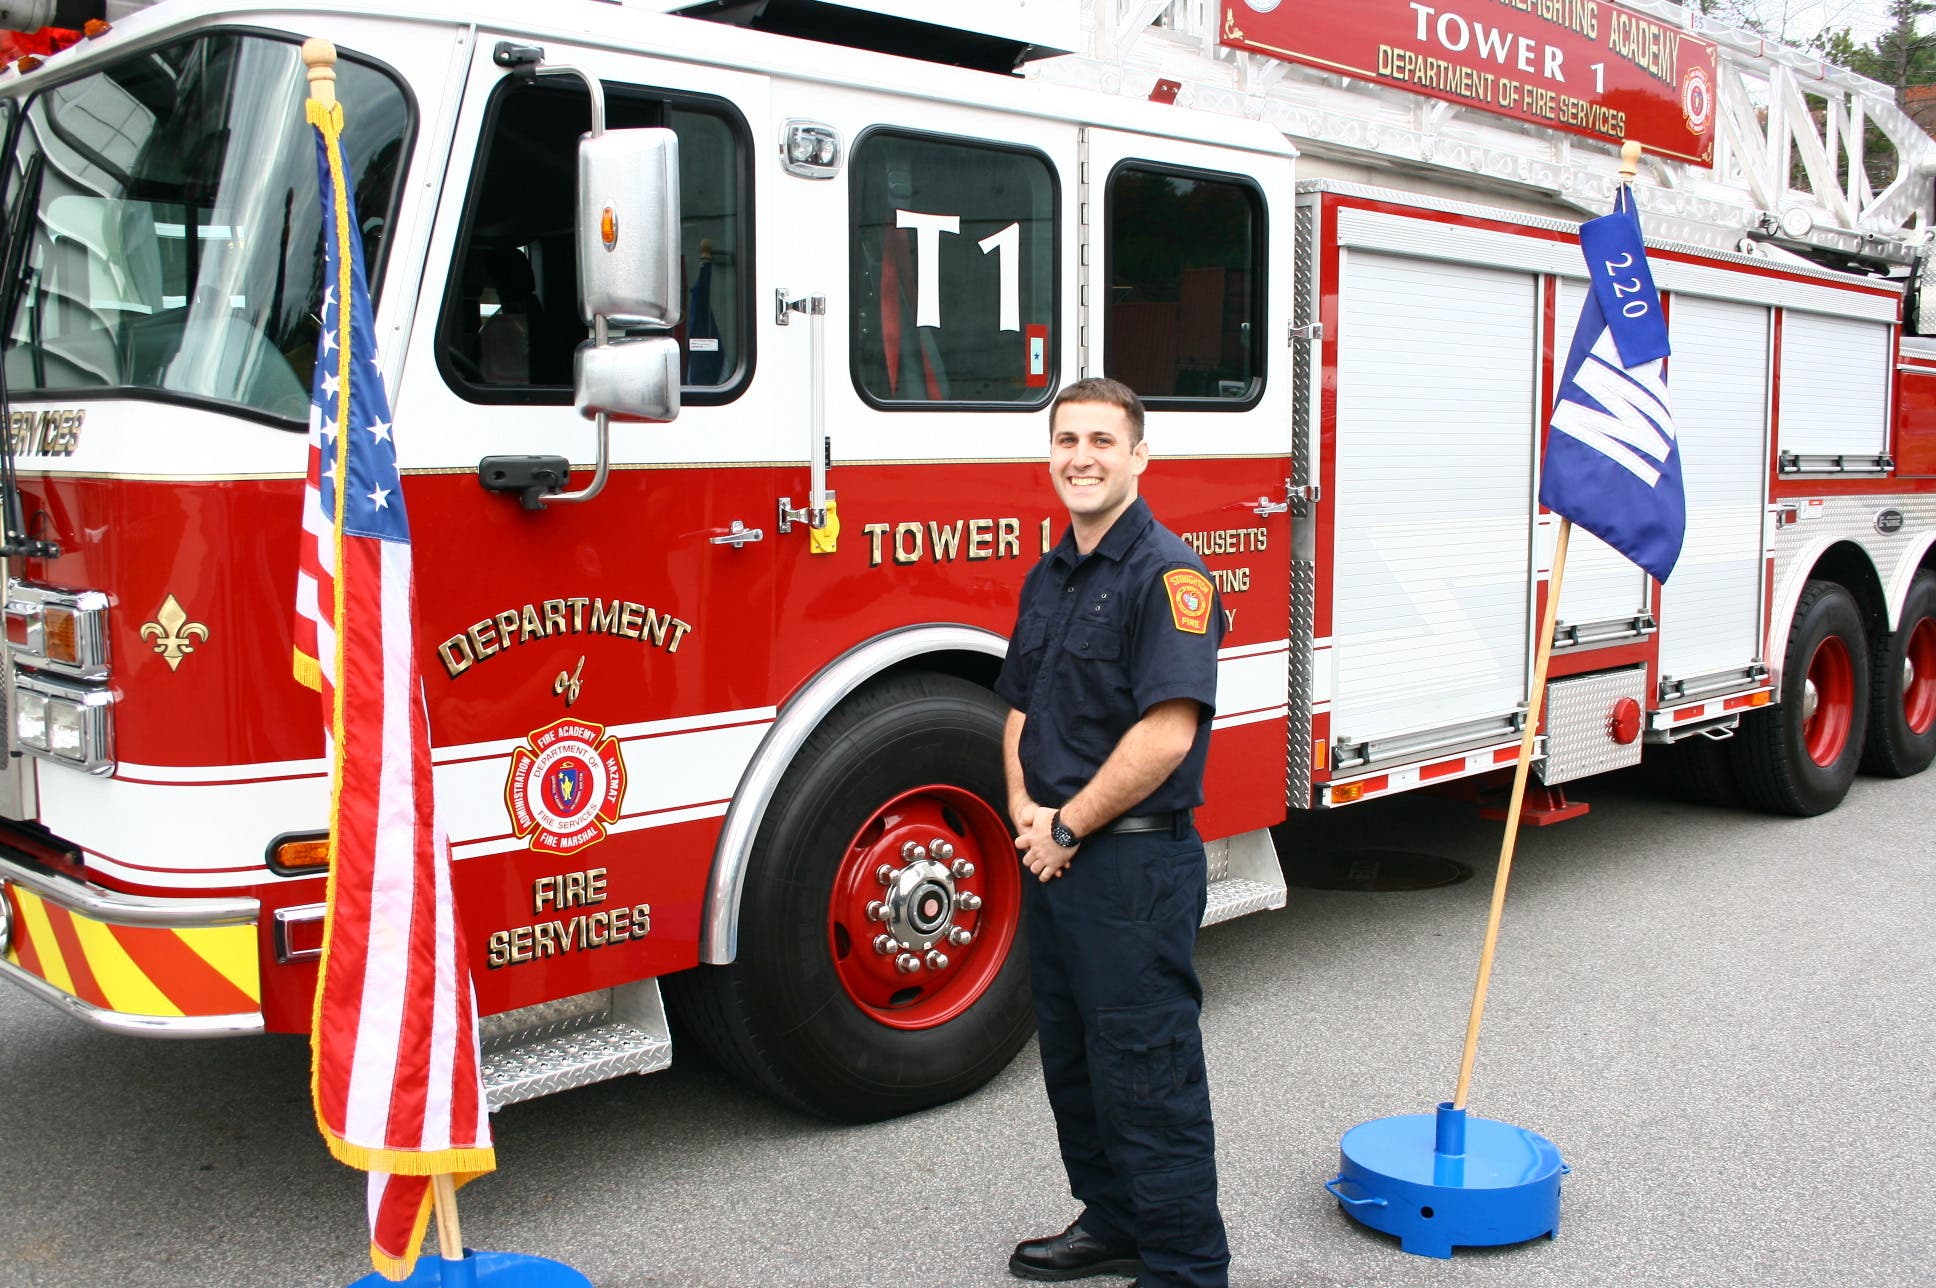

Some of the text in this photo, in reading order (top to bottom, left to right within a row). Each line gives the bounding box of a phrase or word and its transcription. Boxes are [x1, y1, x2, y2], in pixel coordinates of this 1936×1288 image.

[1409, 2, 1604, 94] TOWER 1
[1608, 11, 1681, 89] ACADEMY
[1377, 44, 1626, 137] DEPARTMENT OF FIRE SERVICES
[1604, 252, 1649, 320] 220
[2, 409, 86, 456] ERVICES
[862, 516, 1020, 566] TOWER
[436, 597, 692, 680] DEPARTMENT
[1181, 616, 1201, 629] FIRE
[553, 655, 586, 707] of
[533, 744, 600, 778] DEPARTMENT OF
[537, 725, 597, 749] FIRE ACADEMY
[513, 756, 532, 829] ADMINISTRATION
[605, 757, 620, 804] HAZMAT
[537, 803, 598, 830] FIRE SERVICES
[539, 827, 599, 849] FIRE MARSHAL
[534, 867, 608, 915] FIRE
[487, 903, 652, 970] SERVICES
